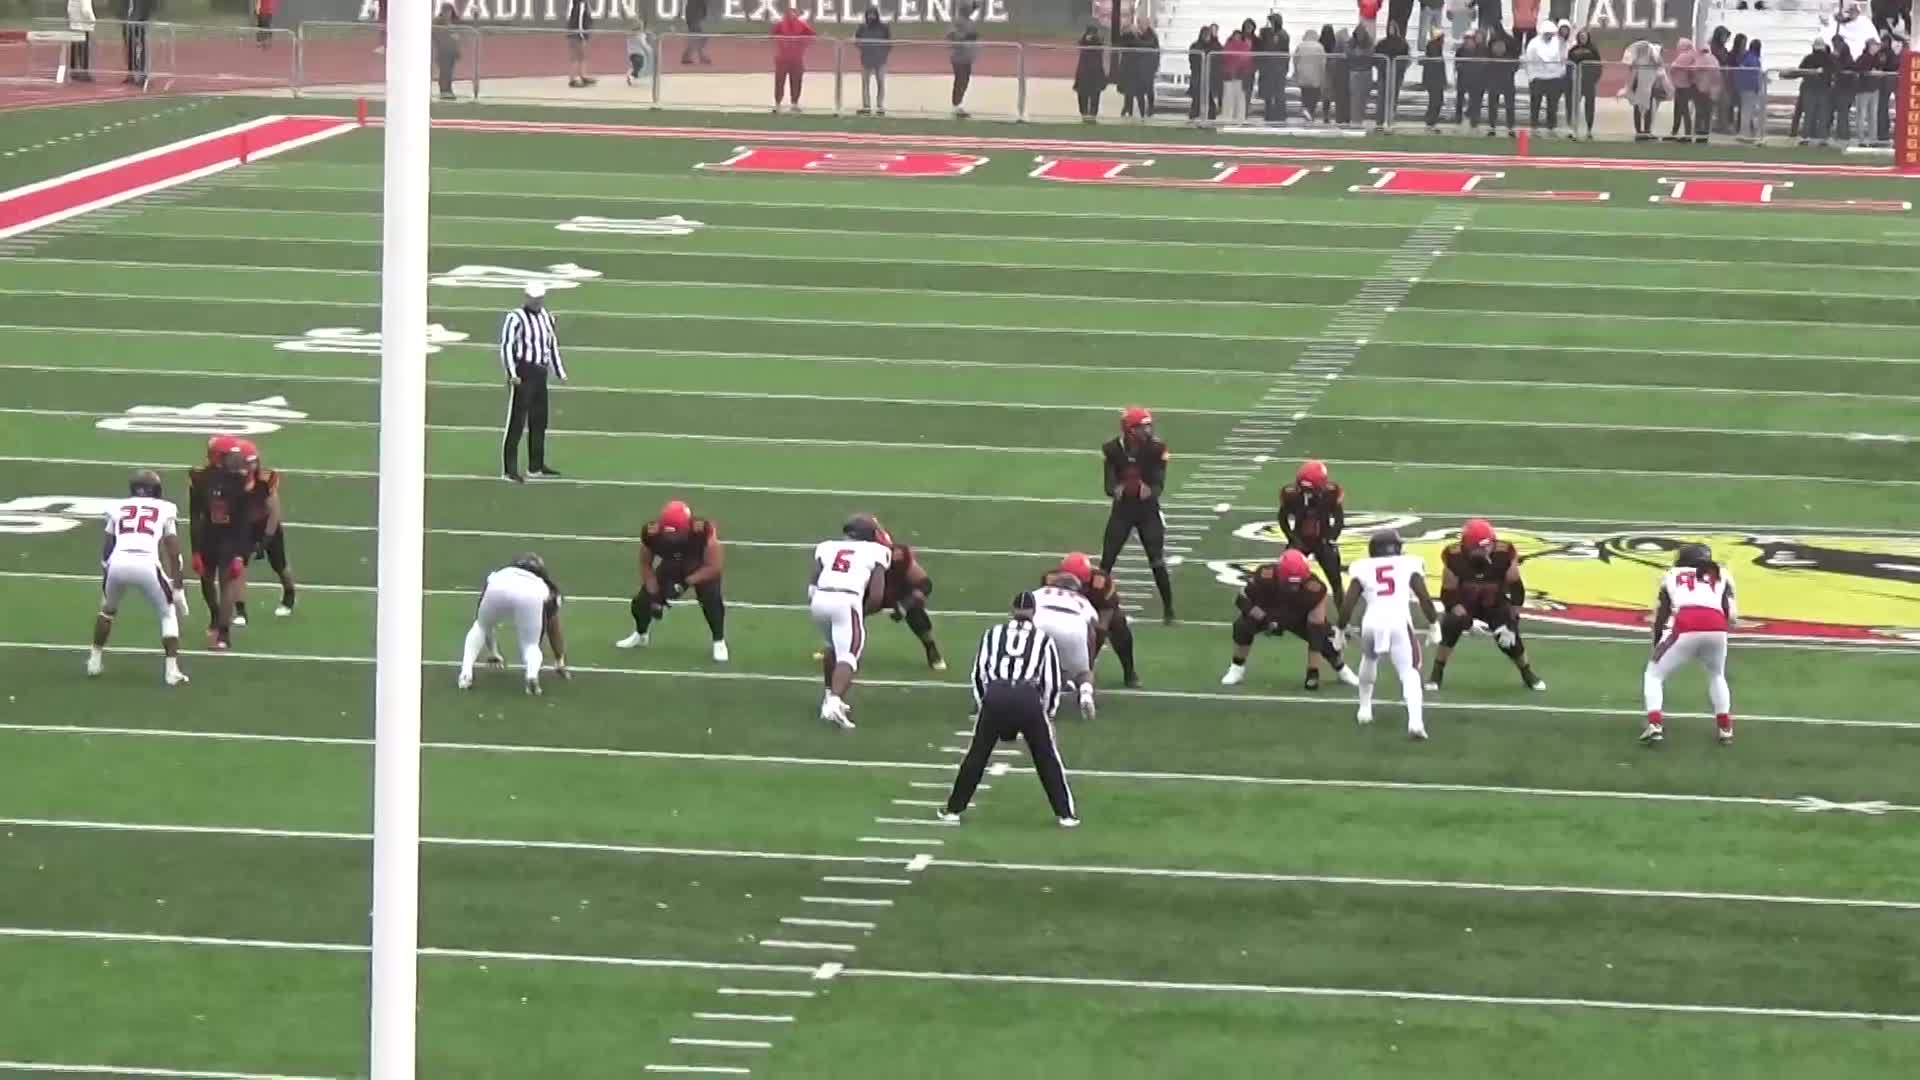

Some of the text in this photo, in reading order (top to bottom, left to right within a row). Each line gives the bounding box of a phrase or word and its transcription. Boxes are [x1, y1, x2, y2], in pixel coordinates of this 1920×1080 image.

[119, 505, 160, 536] 22
[832, 549, 855, 573] 6
[1375, 565, 1396, 597] 5
